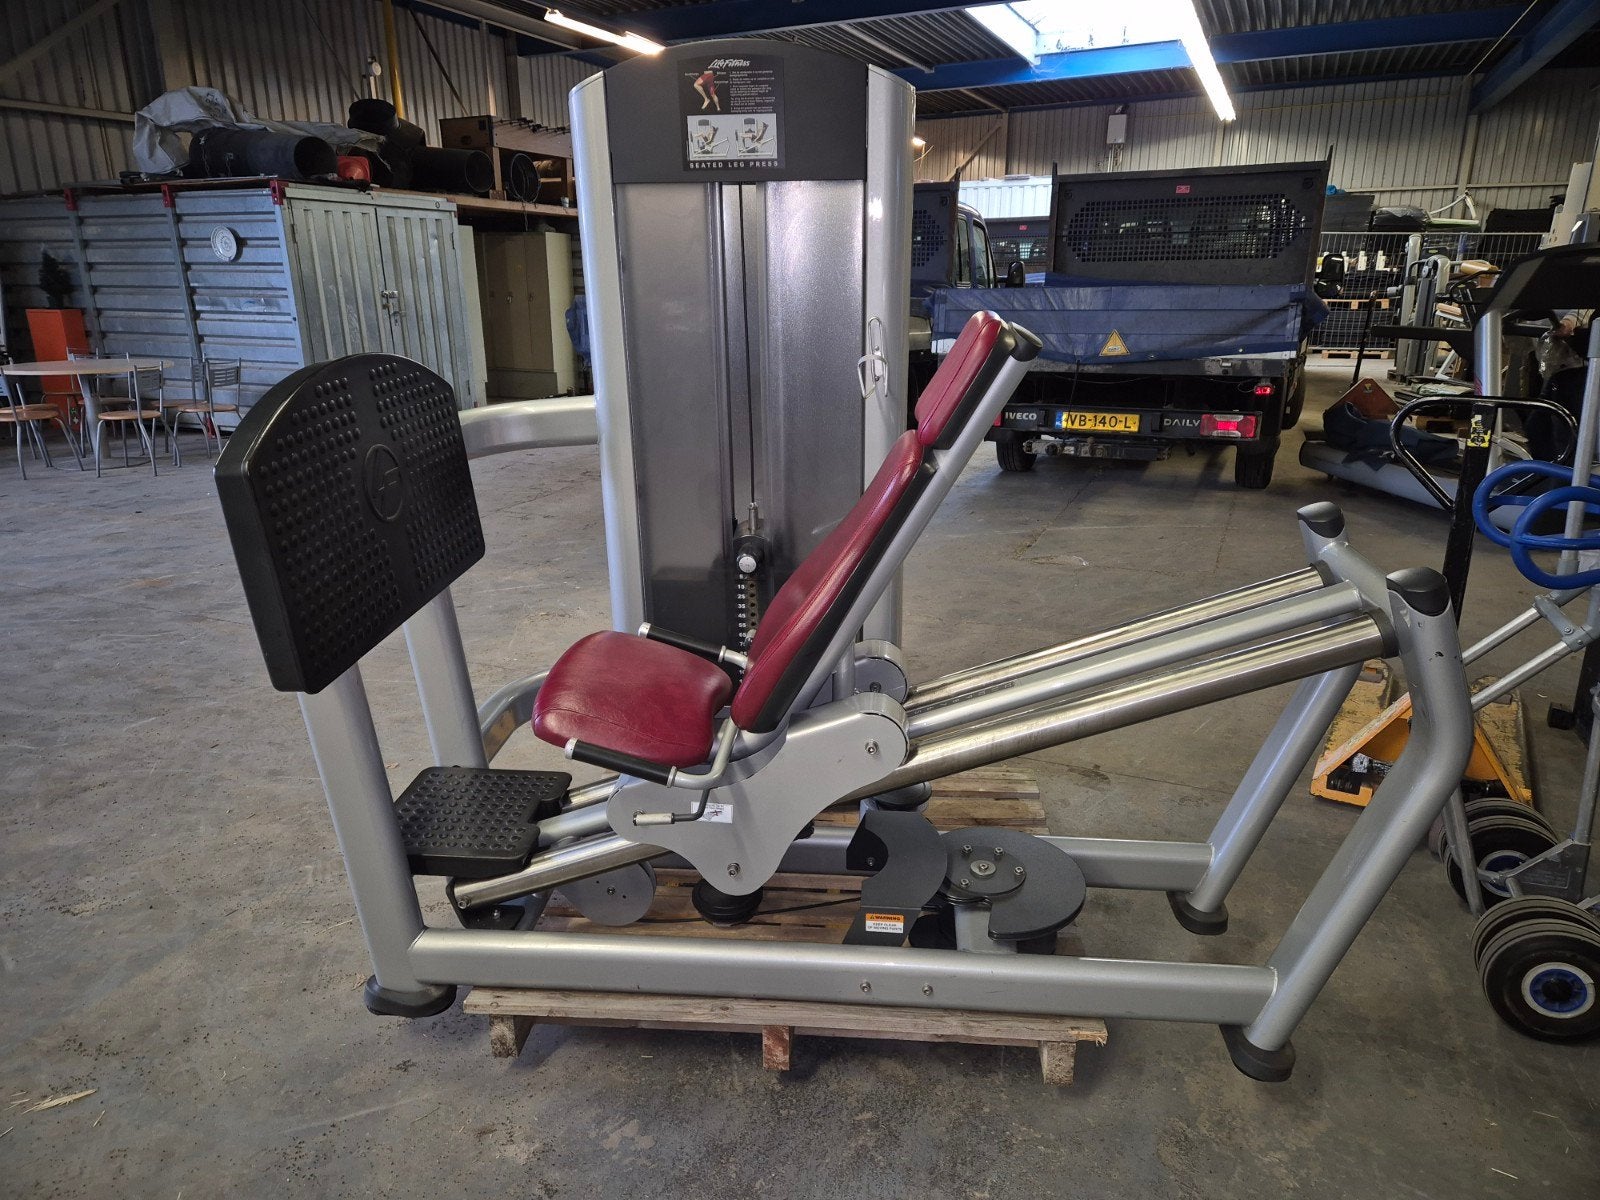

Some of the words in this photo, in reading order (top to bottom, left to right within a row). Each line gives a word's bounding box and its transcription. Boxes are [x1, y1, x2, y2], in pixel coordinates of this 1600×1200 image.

[1004, 411, 1037, 420] IVECO
[1068, 414, 1132, 429] VB-140-L
[1163, 418, 1200, 427] DAILY
